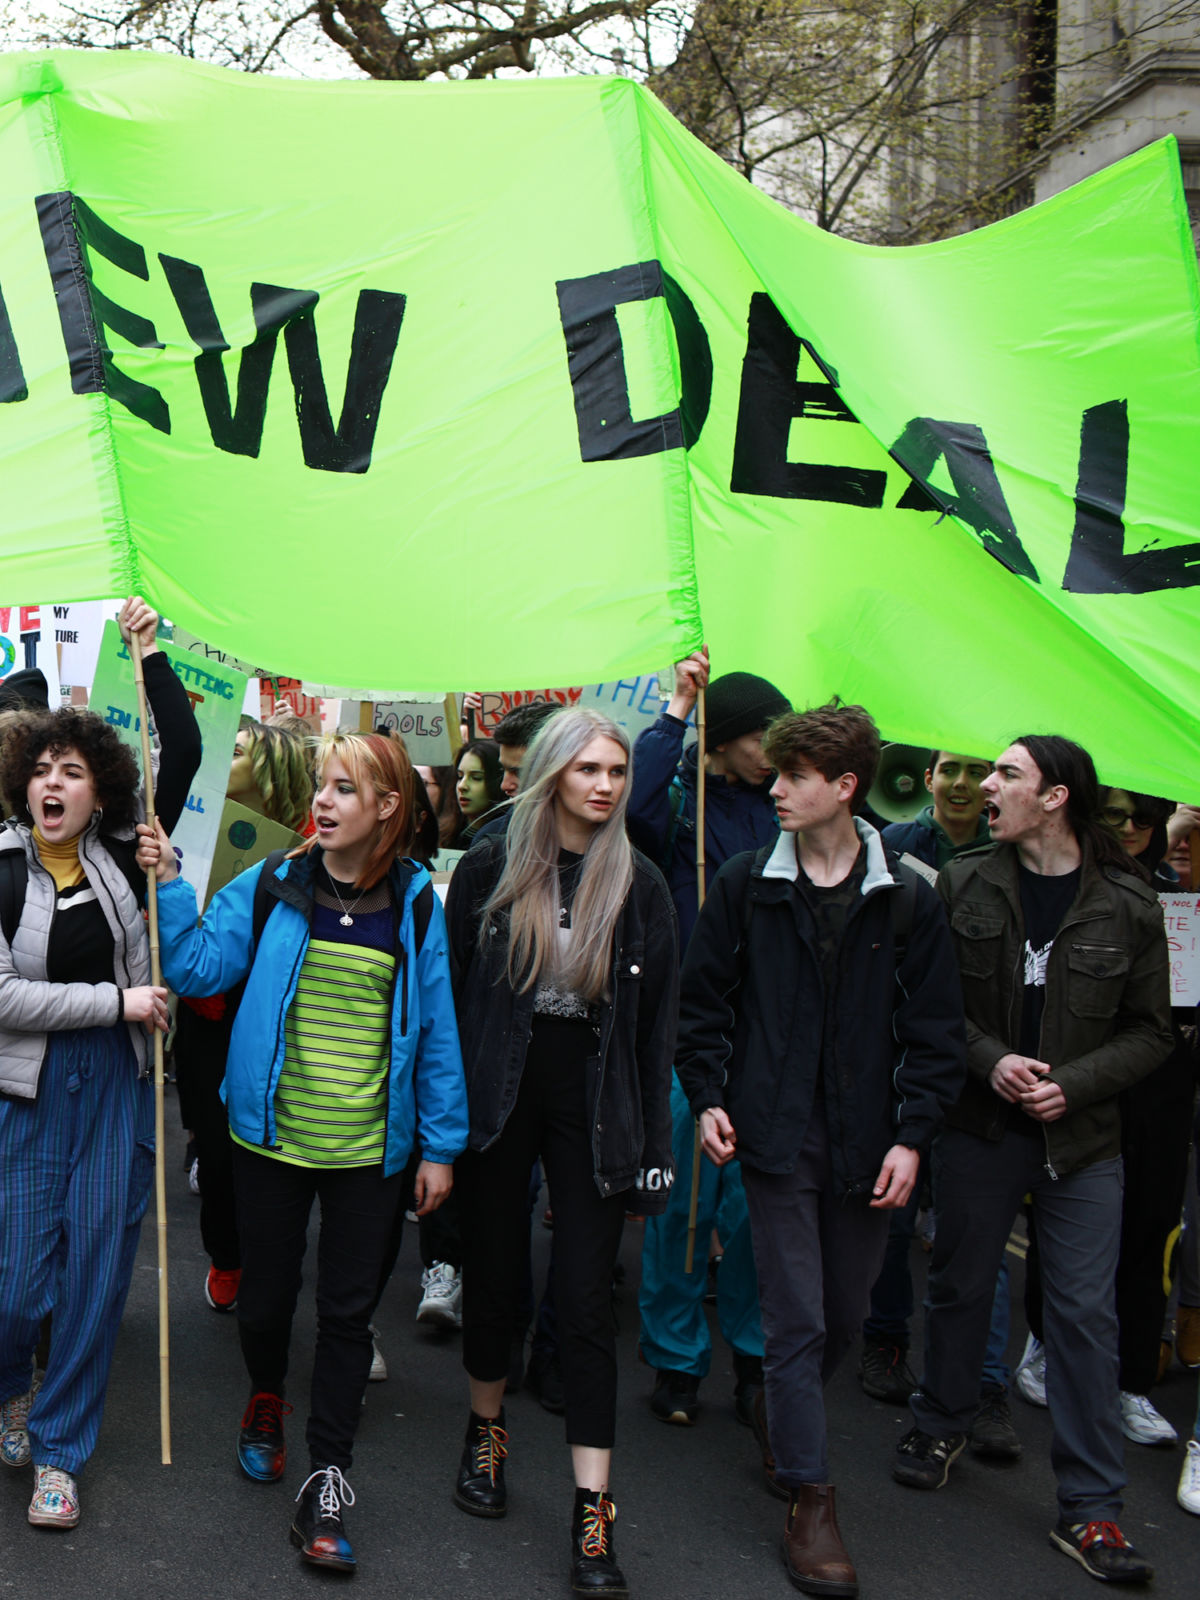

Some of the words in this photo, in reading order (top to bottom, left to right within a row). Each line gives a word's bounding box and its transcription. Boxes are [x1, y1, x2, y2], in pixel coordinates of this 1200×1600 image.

[555, 259, 1200, 595] DEAL
[53, 606, 69, 619] MY
[55, 629, 78, 643] TURE
[166, 657, 234, 700] ETTING
[105, 706, 132, 729] IN
[373, 701, 444, 737] FOOLS
